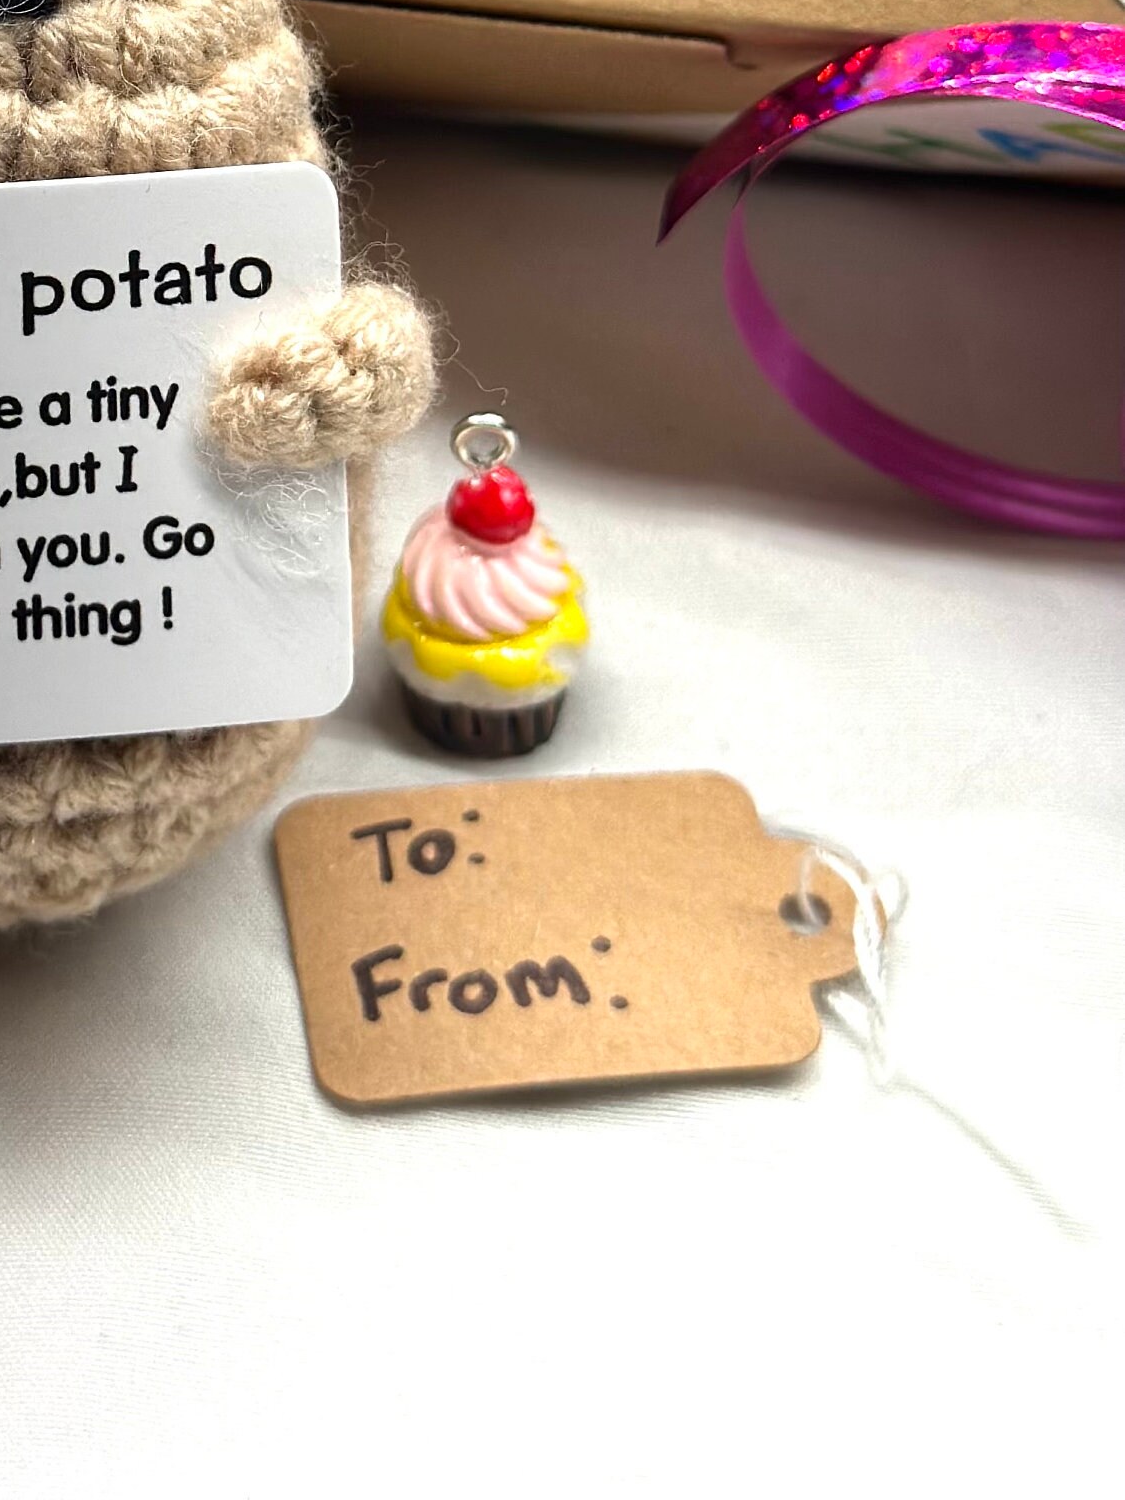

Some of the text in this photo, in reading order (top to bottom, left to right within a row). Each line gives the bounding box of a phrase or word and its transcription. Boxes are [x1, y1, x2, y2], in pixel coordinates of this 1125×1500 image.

[21, 244, 272, 336] potato
[40, 392, 70, 426] a
[87, 376, 178, 430] tiny
[116, 446, 138, 492] I
[17, 532, 124, 578] you.
[143, 516, 214, 559] Go
[12, 593, 141, 645] thing
[350, 807, 485, 884] To:
[350, 935, 630, 1022] From:
